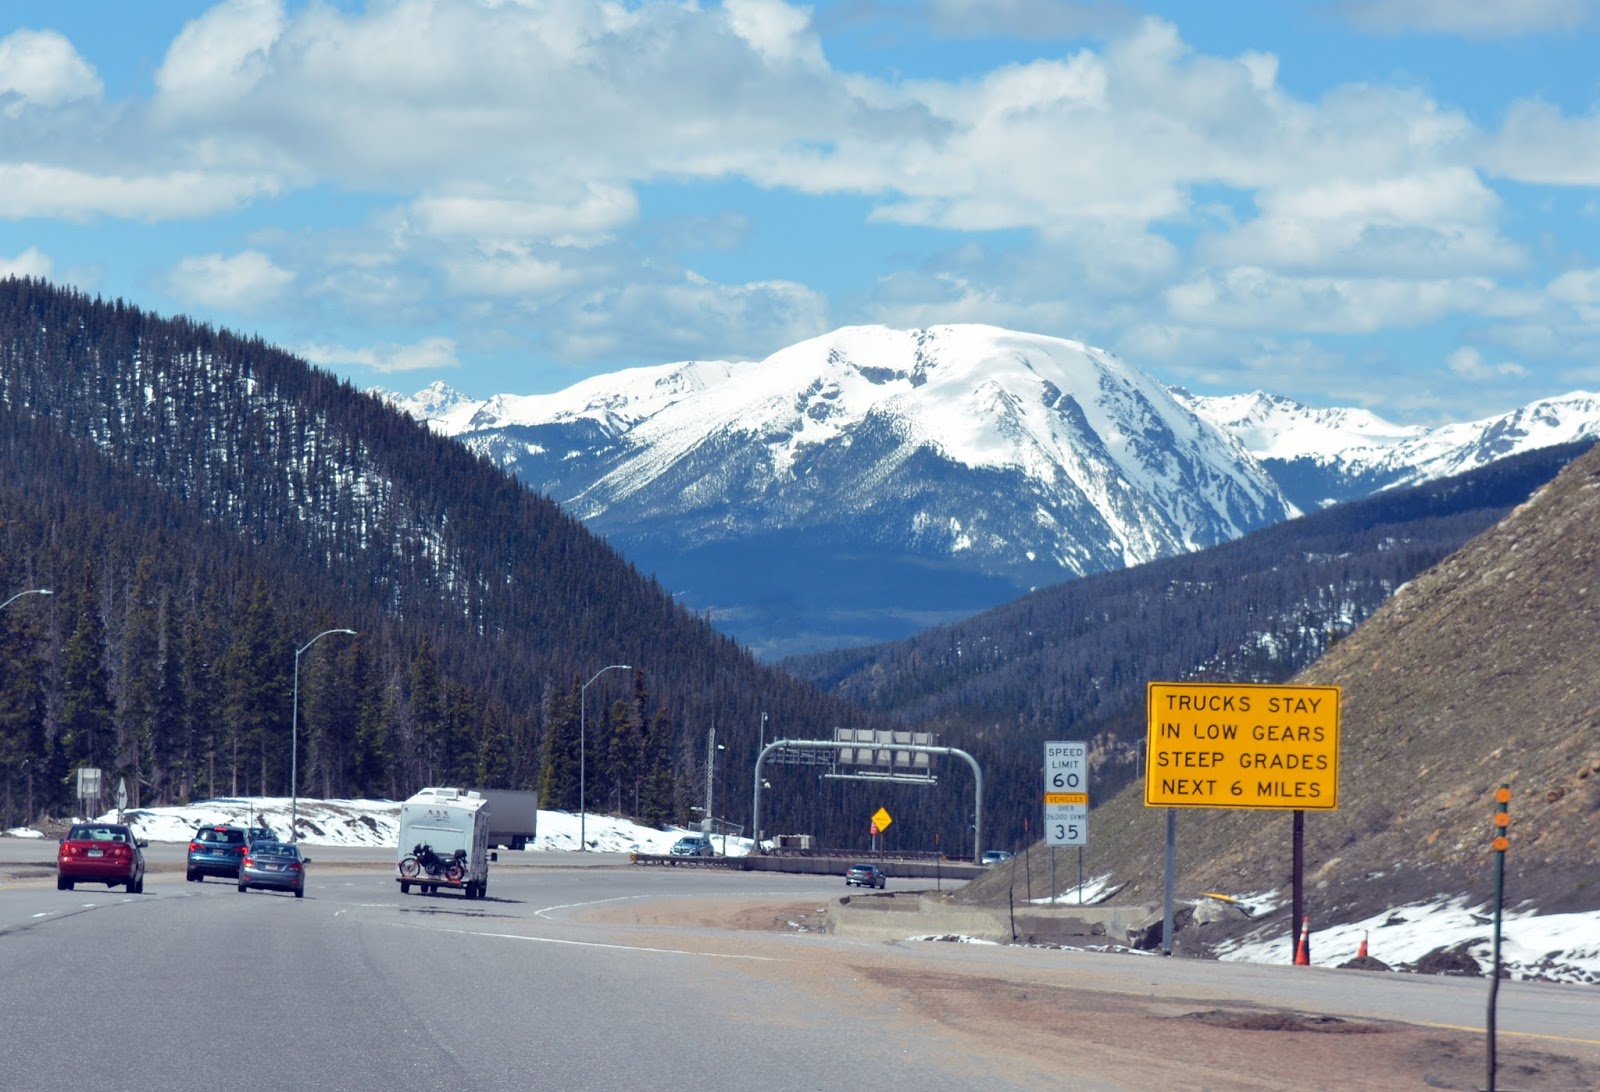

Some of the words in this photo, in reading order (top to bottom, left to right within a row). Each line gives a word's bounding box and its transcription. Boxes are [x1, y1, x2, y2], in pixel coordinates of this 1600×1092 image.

[1166, 695, 1250, 712] TRUCKS
[1268, 698, 1322, 713] STAY
[1161, 723, 1180, 739] IN
[1194, 724, 1238, 740] LOW
[1252, 725, 1325, 741] GEARS
[1048, 748, 1083, 757] SPEED
[1157, 751, 1224, 767] STEEP
[1239, 753, 1328, 770] GRADES
[1052, 760, 1079, 769] LIMIT
[1053, 773, 1079, 788] 60
[1162, 779, 1217, 795] NEXT
[1231, 781, 1243, 796] 6
[1257, 781, 1321, 798] MILES
[1055, 824, 1078, 840] 35
